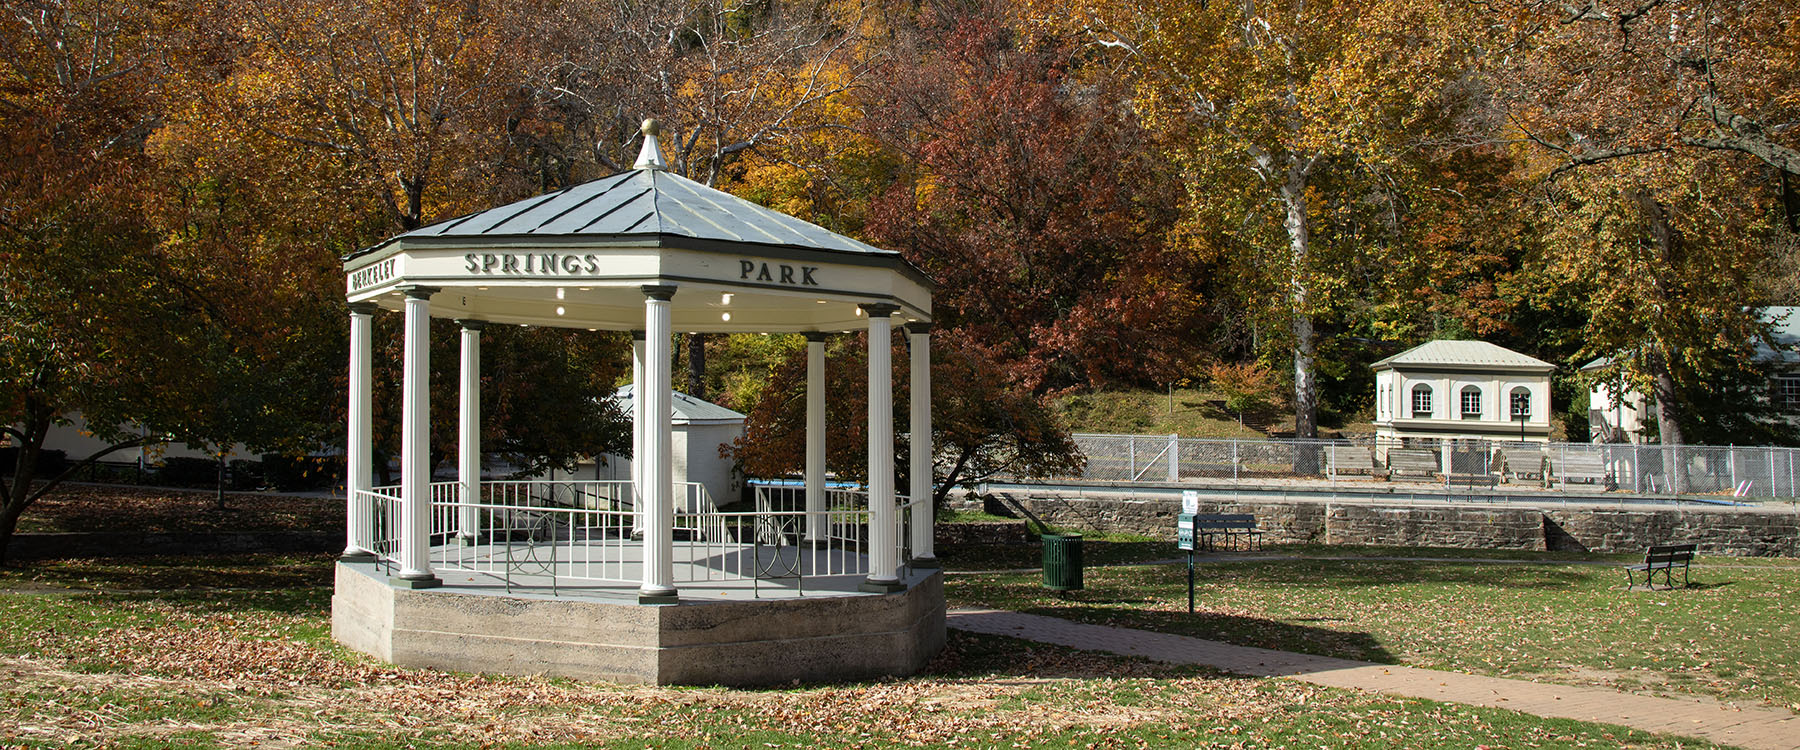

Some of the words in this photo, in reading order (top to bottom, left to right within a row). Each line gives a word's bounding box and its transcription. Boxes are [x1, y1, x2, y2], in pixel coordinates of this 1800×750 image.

[352, 259, 395, 290] BERKELEY
[464, 253, 599, 274] SPRINGS
[740, 260, 818, 285] PARK
